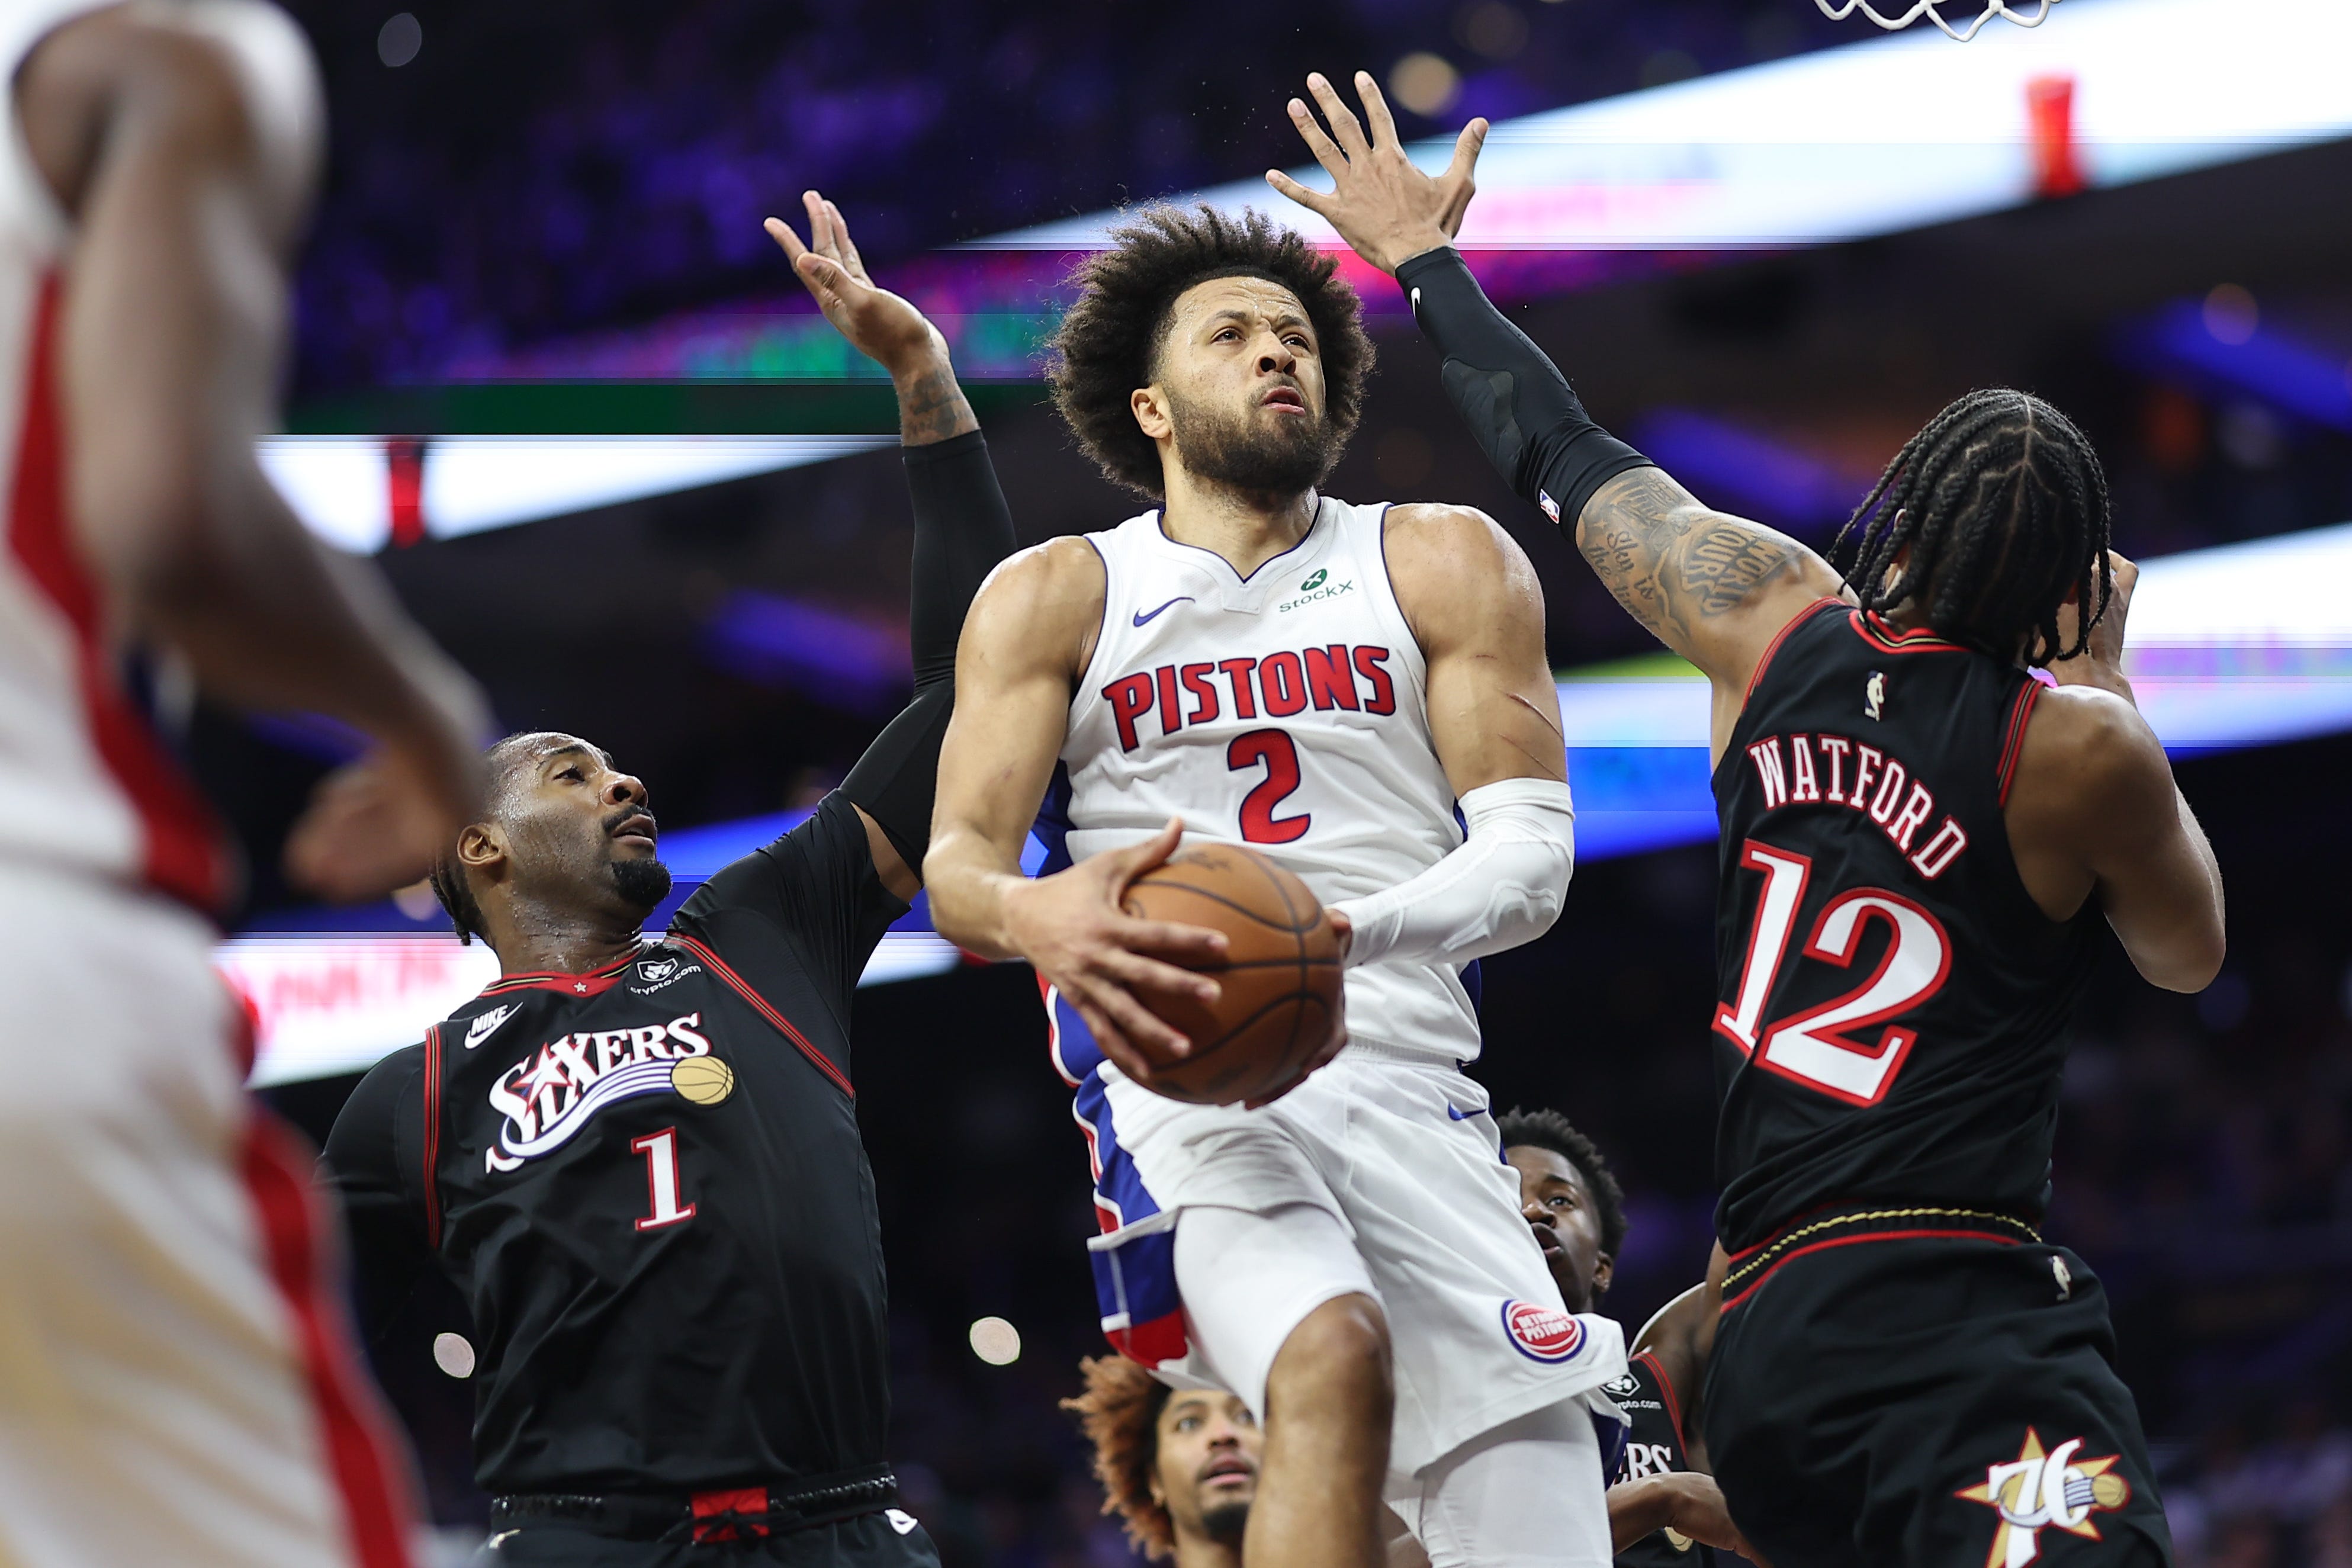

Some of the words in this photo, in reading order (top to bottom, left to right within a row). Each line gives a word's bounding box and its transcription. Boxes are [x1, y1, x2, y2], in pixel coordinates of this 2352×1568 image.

[1101, 644, 1396, 754] PISTONS
[1227, 728, 1311, 844] 2
[1746, 733, 1968, 880] WATFORD
[471, 1004, 509, 1037] NIKE
[629, 964, 702, 996] crypto.com
[1711, 838, 1953, 1108] 12
[486, 1011, 711, 1175] SIXERS
[630, 1126, 697, 1232] 1
[1987, 1435, 2091, 1568] 76
